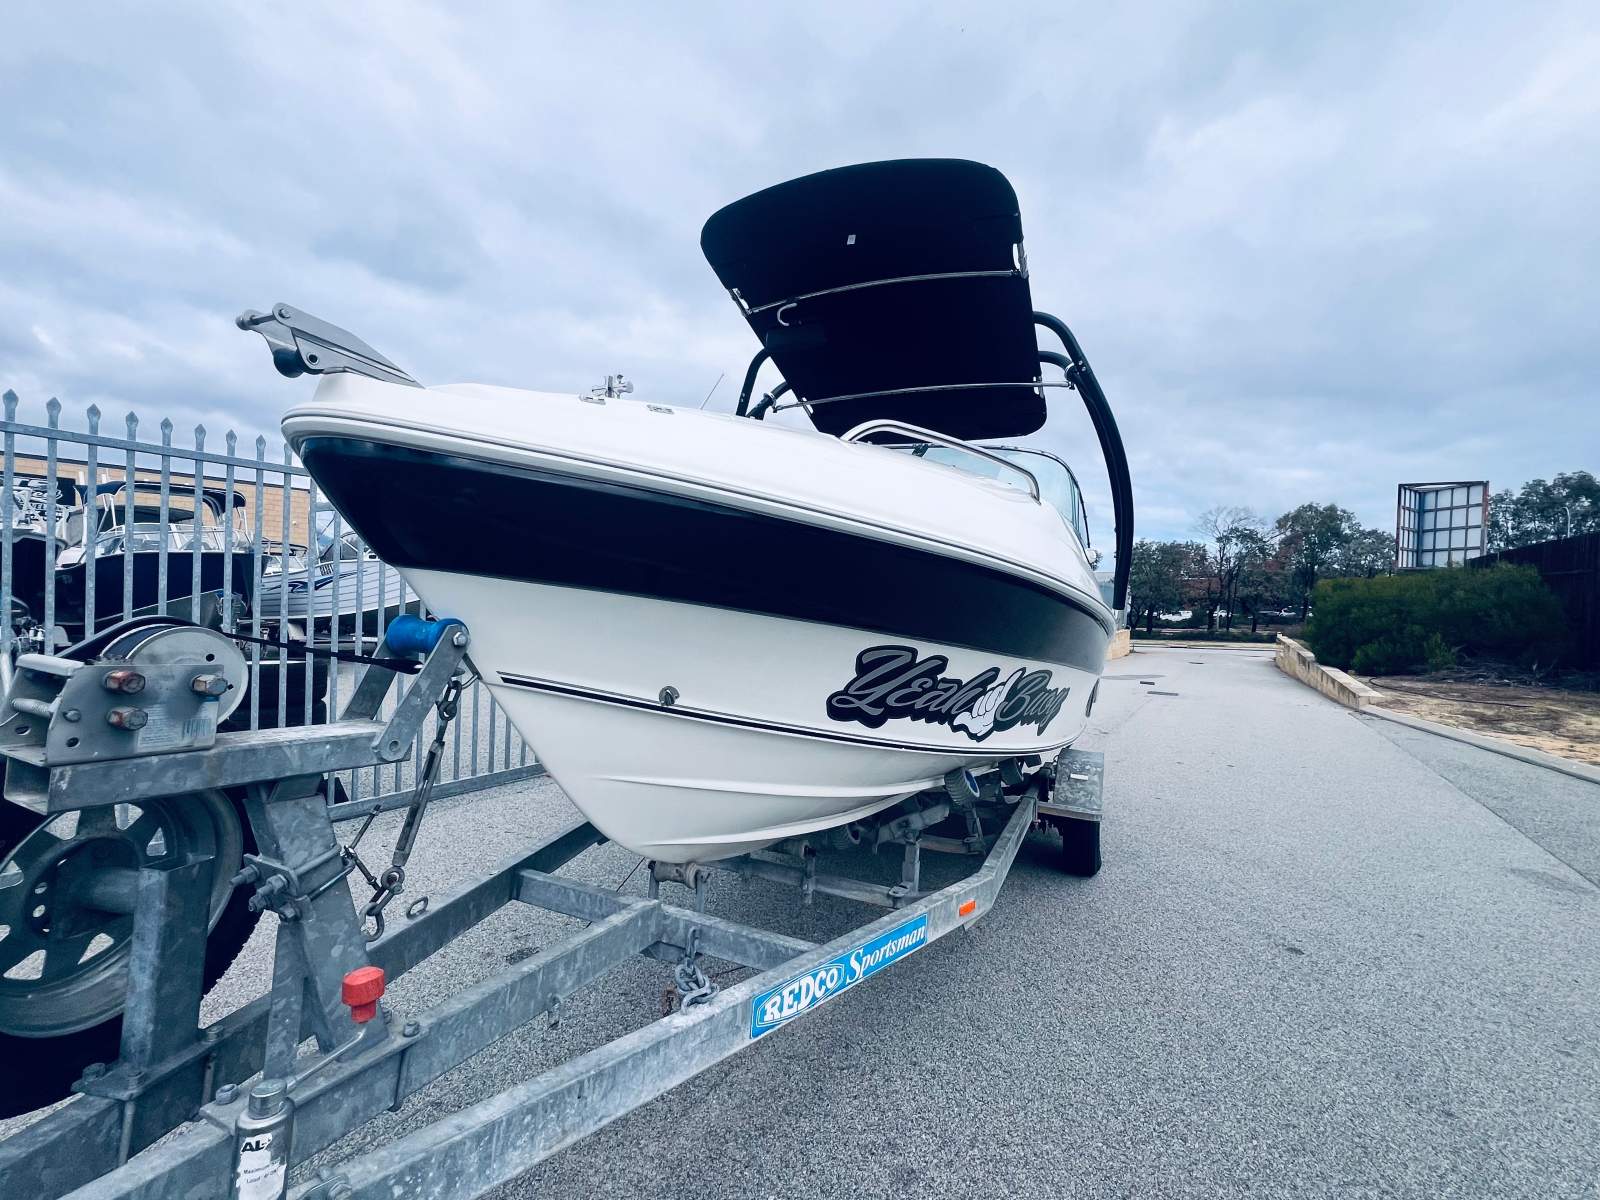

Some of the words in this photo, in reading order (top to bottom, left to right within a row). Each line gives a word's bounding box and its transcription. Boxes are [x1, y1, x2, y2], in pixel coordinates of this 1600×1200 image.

[828, 646, 1000, 726] Yeah
[764, 967, 839, 1022] REDCO
[846, 925, 926, 985] Sportsman
